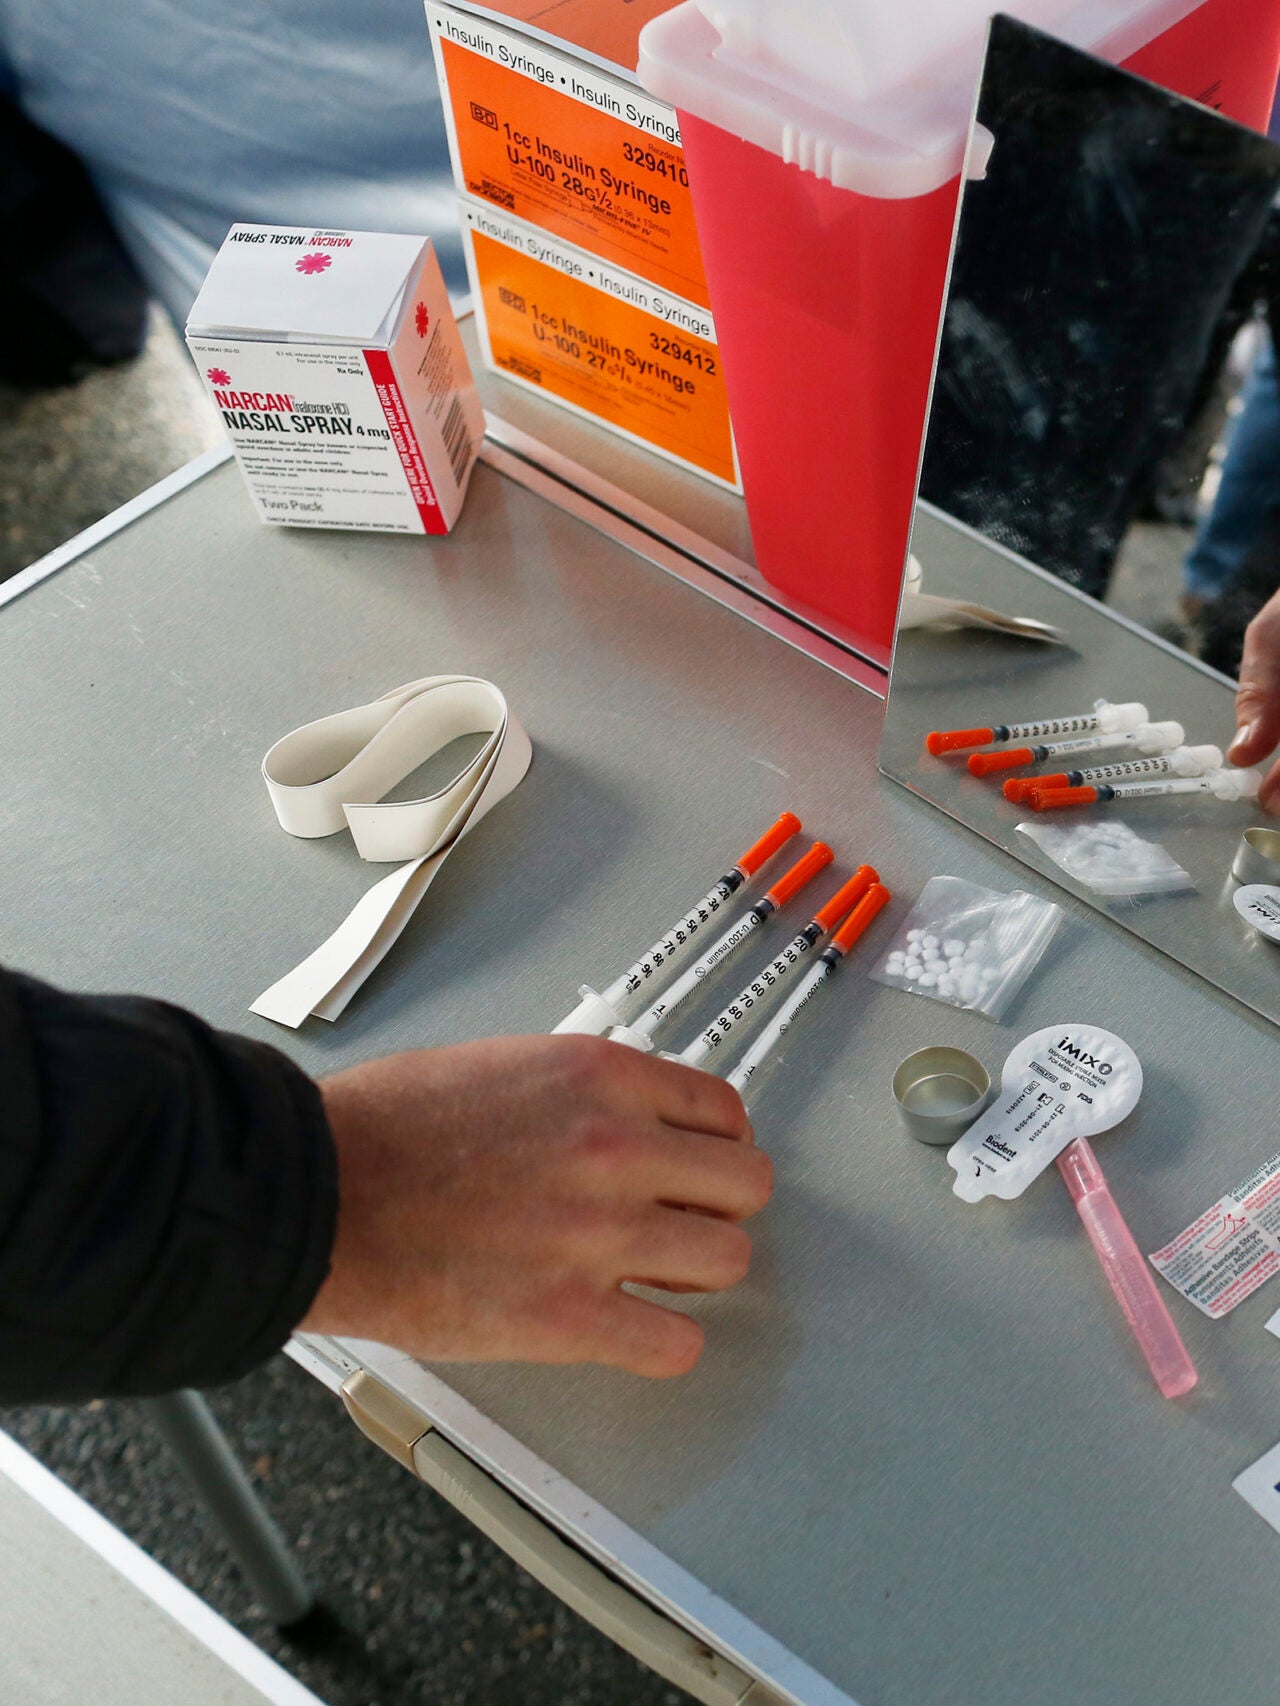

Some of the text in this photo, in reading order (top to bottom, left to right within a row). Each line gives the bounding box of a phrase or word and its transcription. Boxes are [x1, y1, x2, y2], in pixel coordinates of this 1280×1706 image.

[447, 21, 493, 55] Insulin
[499, 45, 554, 83] Syringe
[572, 79, 620, 114] Insulin
[504, 123, 531, 149] 1cc
[536, 137, 595, 180] Insulin
[600, 168, 670, 214] Syringe
[507, 145, 555, 181] U-100
[624, 143, 689, 187] 329410
[231, 232, 353, 247] NARCAN NASAL SPRAY
[477, 216, 709, 335] Insulin Syringe Insulin Syringe
[532, 304, 695, 394] 1cc Insulin Syringe
[533, 324, 580, 358] U-100
[651, 333, 715, 375] 329412
[214, 391, 292, 412] NARCAN
[223, 411, 390, 440] NASAL SPRAY 4 mg
[260, 498, 323, 511] Two Pack
[641, 887, 731, 979] 20 30 40 50 60 70 80 90
[728, 924, 750, 946] U-100
[794, 938, 808, 952] 20
[773, 961, 787, 975] 40
[783, 949, 798, 963] 30
[751, 983, 765, 997] 60
[761, 971, 776, 986] 50
[728, 1006, 743, 1020] 80
[740, 994, 754, 1008] 70
[717, 1017, 732, 1032] 90
[986, 1135, 1016, 1157] Biodent
[1233, 1176, 1265, 1202] Banditas
[1184, 1230, 1260, 1295] Adhesive Bandage Strips
[1200, 1245, 1269, 1304] Banditas Adhesivas
[1193, 1263, 1236, 1298] Pansements
